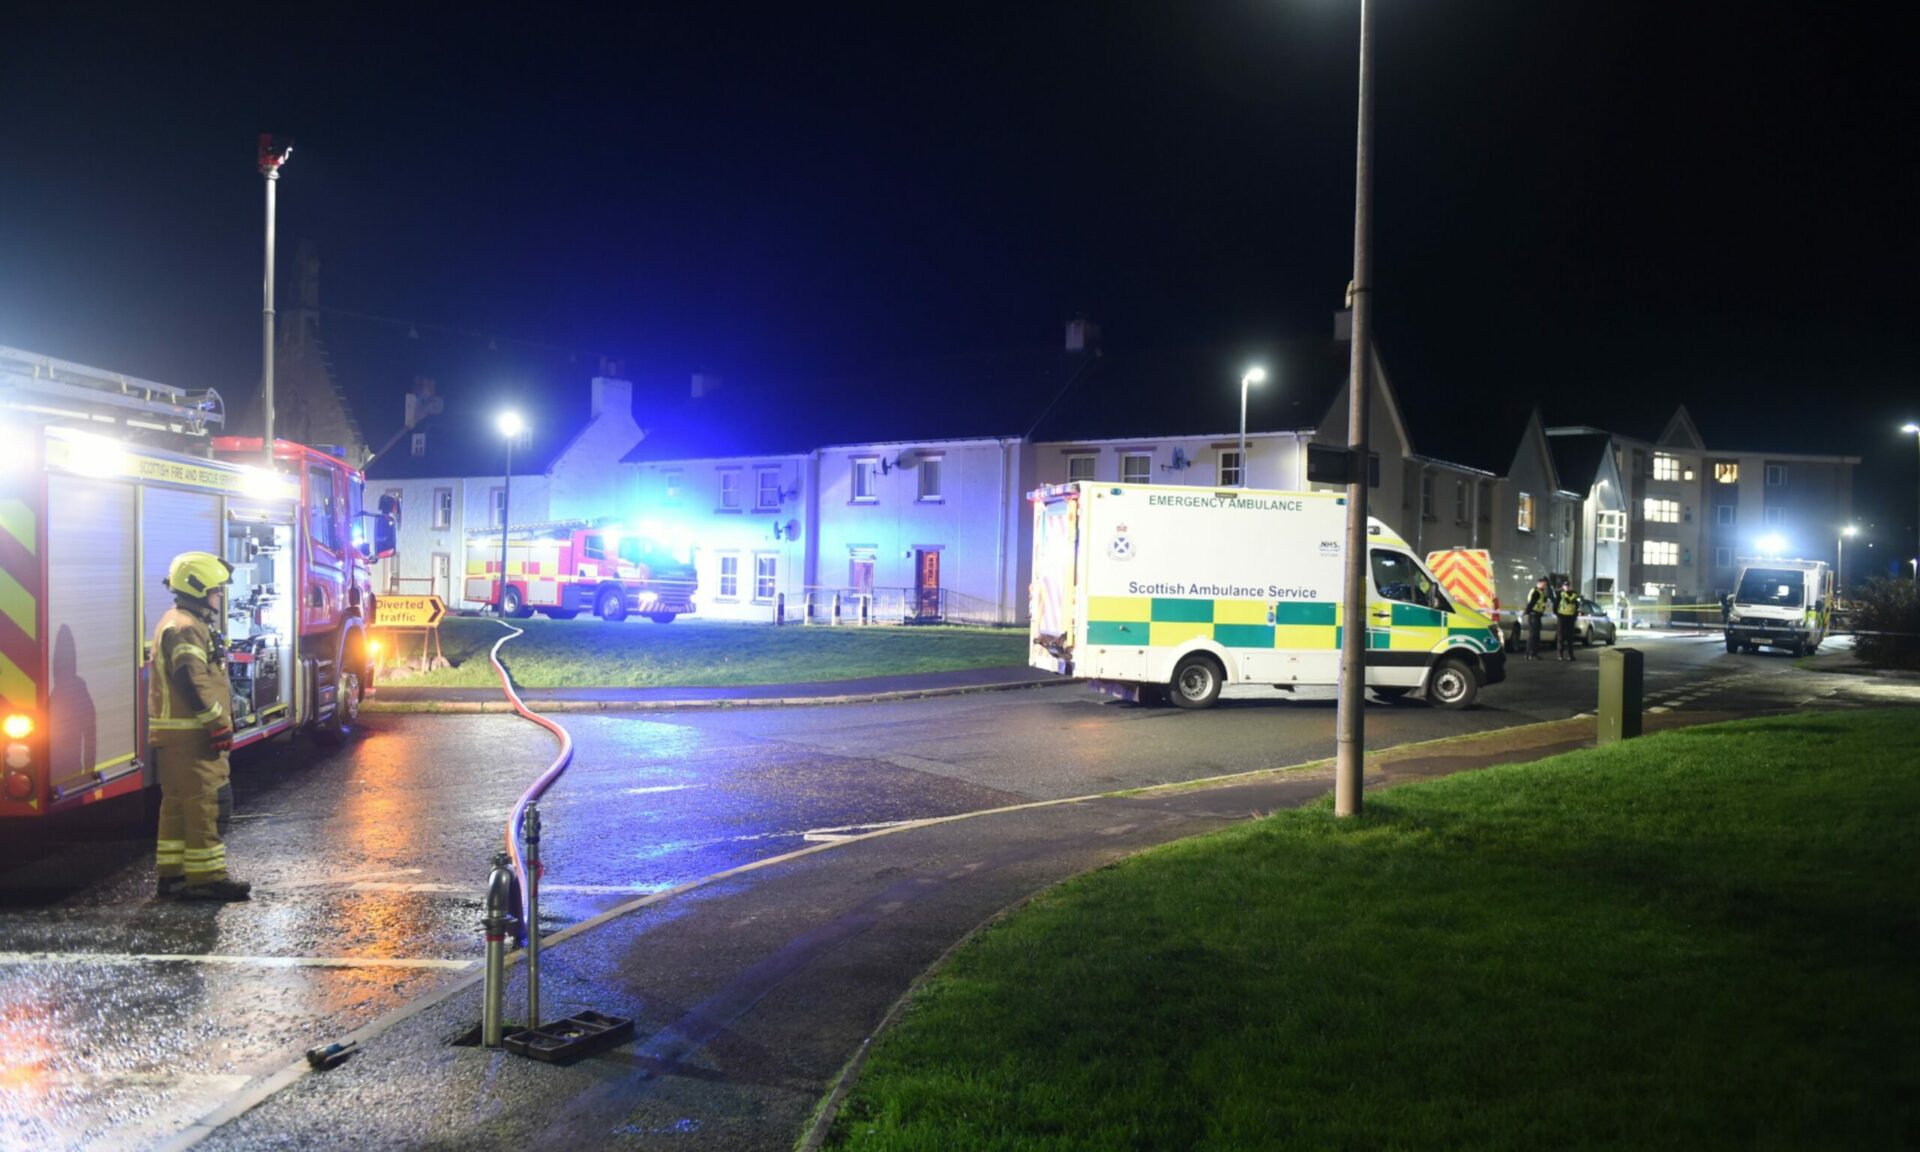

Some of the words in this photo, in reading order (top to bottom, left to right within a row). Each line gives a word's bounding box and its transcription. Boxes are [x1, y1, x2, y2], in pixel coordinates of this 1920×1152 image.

[1149, 495, 1225, 508] EMERGENCY
[1229, 498, 1303, 511] AMBULANCE
[1129, 581, 1185, 595] Scottish
[1189, 583, 1265, 597] Ambulance
[1268, 585, 1317, 598] Service
[375, 600, 424, 609] Diverted
[381, 612, 416, 622] traffic
